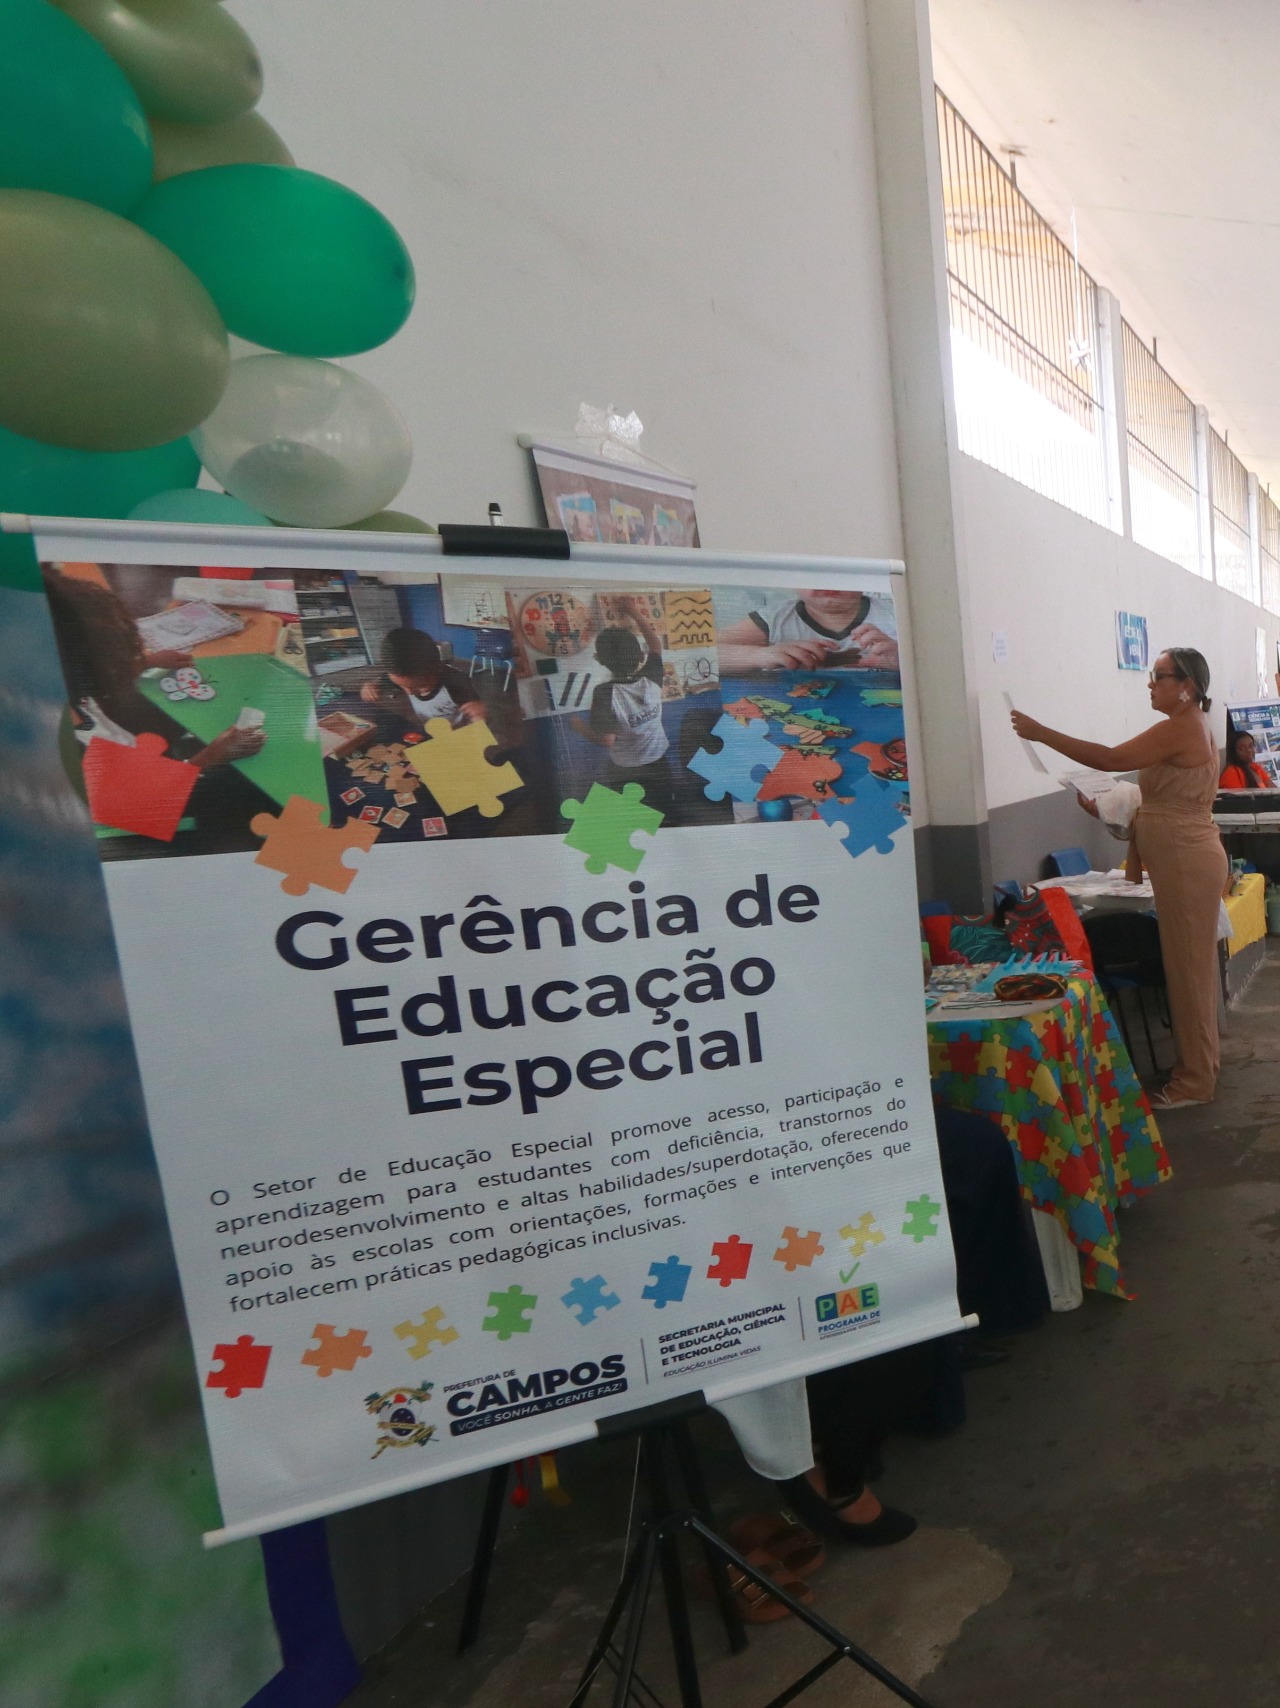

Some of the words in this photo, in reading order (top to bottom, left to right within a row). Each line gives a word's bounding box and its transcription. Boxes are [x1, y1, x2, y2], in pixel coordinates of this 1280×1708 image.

[275, 880, 699, 971] Gerência
[725, 873, 820, 929] de
[334, 947, 776, 1046] Educação
[401, 1011, 763, 1115] Especial
[210, 1190, 230, 1206] O
[253, 1177, 316, 1199] Setor
[338, 1167, 367, 1184] de
[388, 1149, 492, 1176] Educação
[511, 1132, 592, 1159] Especial
[611, 1116, 691, 1146] promove
[708, 1103, 769, 1122] acesso,
[785, 1081, 881, 1112] participação
[894, 1077, 904, 1088] e
[215, 1193, 385, 1235] aprendizagem
[407, 1182, 457, 1204] para
[478, 1161, 592, 1188] estudantes
[611, 1149, 650, 1167] com
[668, 1126, 764, 1155] deficiência,
[779, 1105, 872, 1132] transtornos
[886, 1098, 906, 1111] do
[220, 1203, 485, 1260] neurodesenvolvimento
[497, 1199, 509, 1211] e
[521, 1190, 569, 1207] altas
[579, 1140, 813, 1198] habilidades/superdotação,
[821, 1119, 908, 1147] oferecendo
[226, 1262, 293, 1287] apoio
[311, 1254, 336, 1270] às
[352, 1237, 434, 1262] escolas
[449, 1227, 494, 1244] com
[509, 1203, 631, 1234] orientações,
[643, 1178, 737, 1209] formações
[749, 1174, 759, 1185] e
[771, 1150, 872, 1180] intervenções
[883, 1142, 911, 1159] que
[229, 1278, 358, 1312] fortalecem
[365, 1260, 452, 1291] práticas
[459, 1236, 587, 1273] pedagógicas
[592, 1215, 686, 1245] inclusivas.
[658, 1318, 726, 1344] SECRETARIA
[727, 1303, 786, 1325] MUNICIPAL
[660, 1343, 678, 1355] DE
[678, 1326, 742, 1350] EDUCAÇÃO,
[743, 1313, 786, 1332] CIÊNCIA
[818, 1314, 868, 1334] PROGRAMA
[869, 1310, 881, 1320] DE
[819, 1286, 876, 1320] PAE
[443, 1374, 502, 1393] PREFEITURA
[503, 1368, 517, 1379] DE
[661, 1356, 670, 1366] E
[671, 1337, 742, 1364] TECNOLOGIA
[662, 1360, 706, 1378] EDUCAÇÃO
[706, 1351, 740, 1368] ILUMINA
[739, 1344, 762, 1359] VIDAS
[446, 1354, 626, 1417] CAMPOS
[457, 1413, 492, 1432] VOCÊ
[544, 1400, 554, 1410] A
[555, 1389, 596, 1407] GENTE
